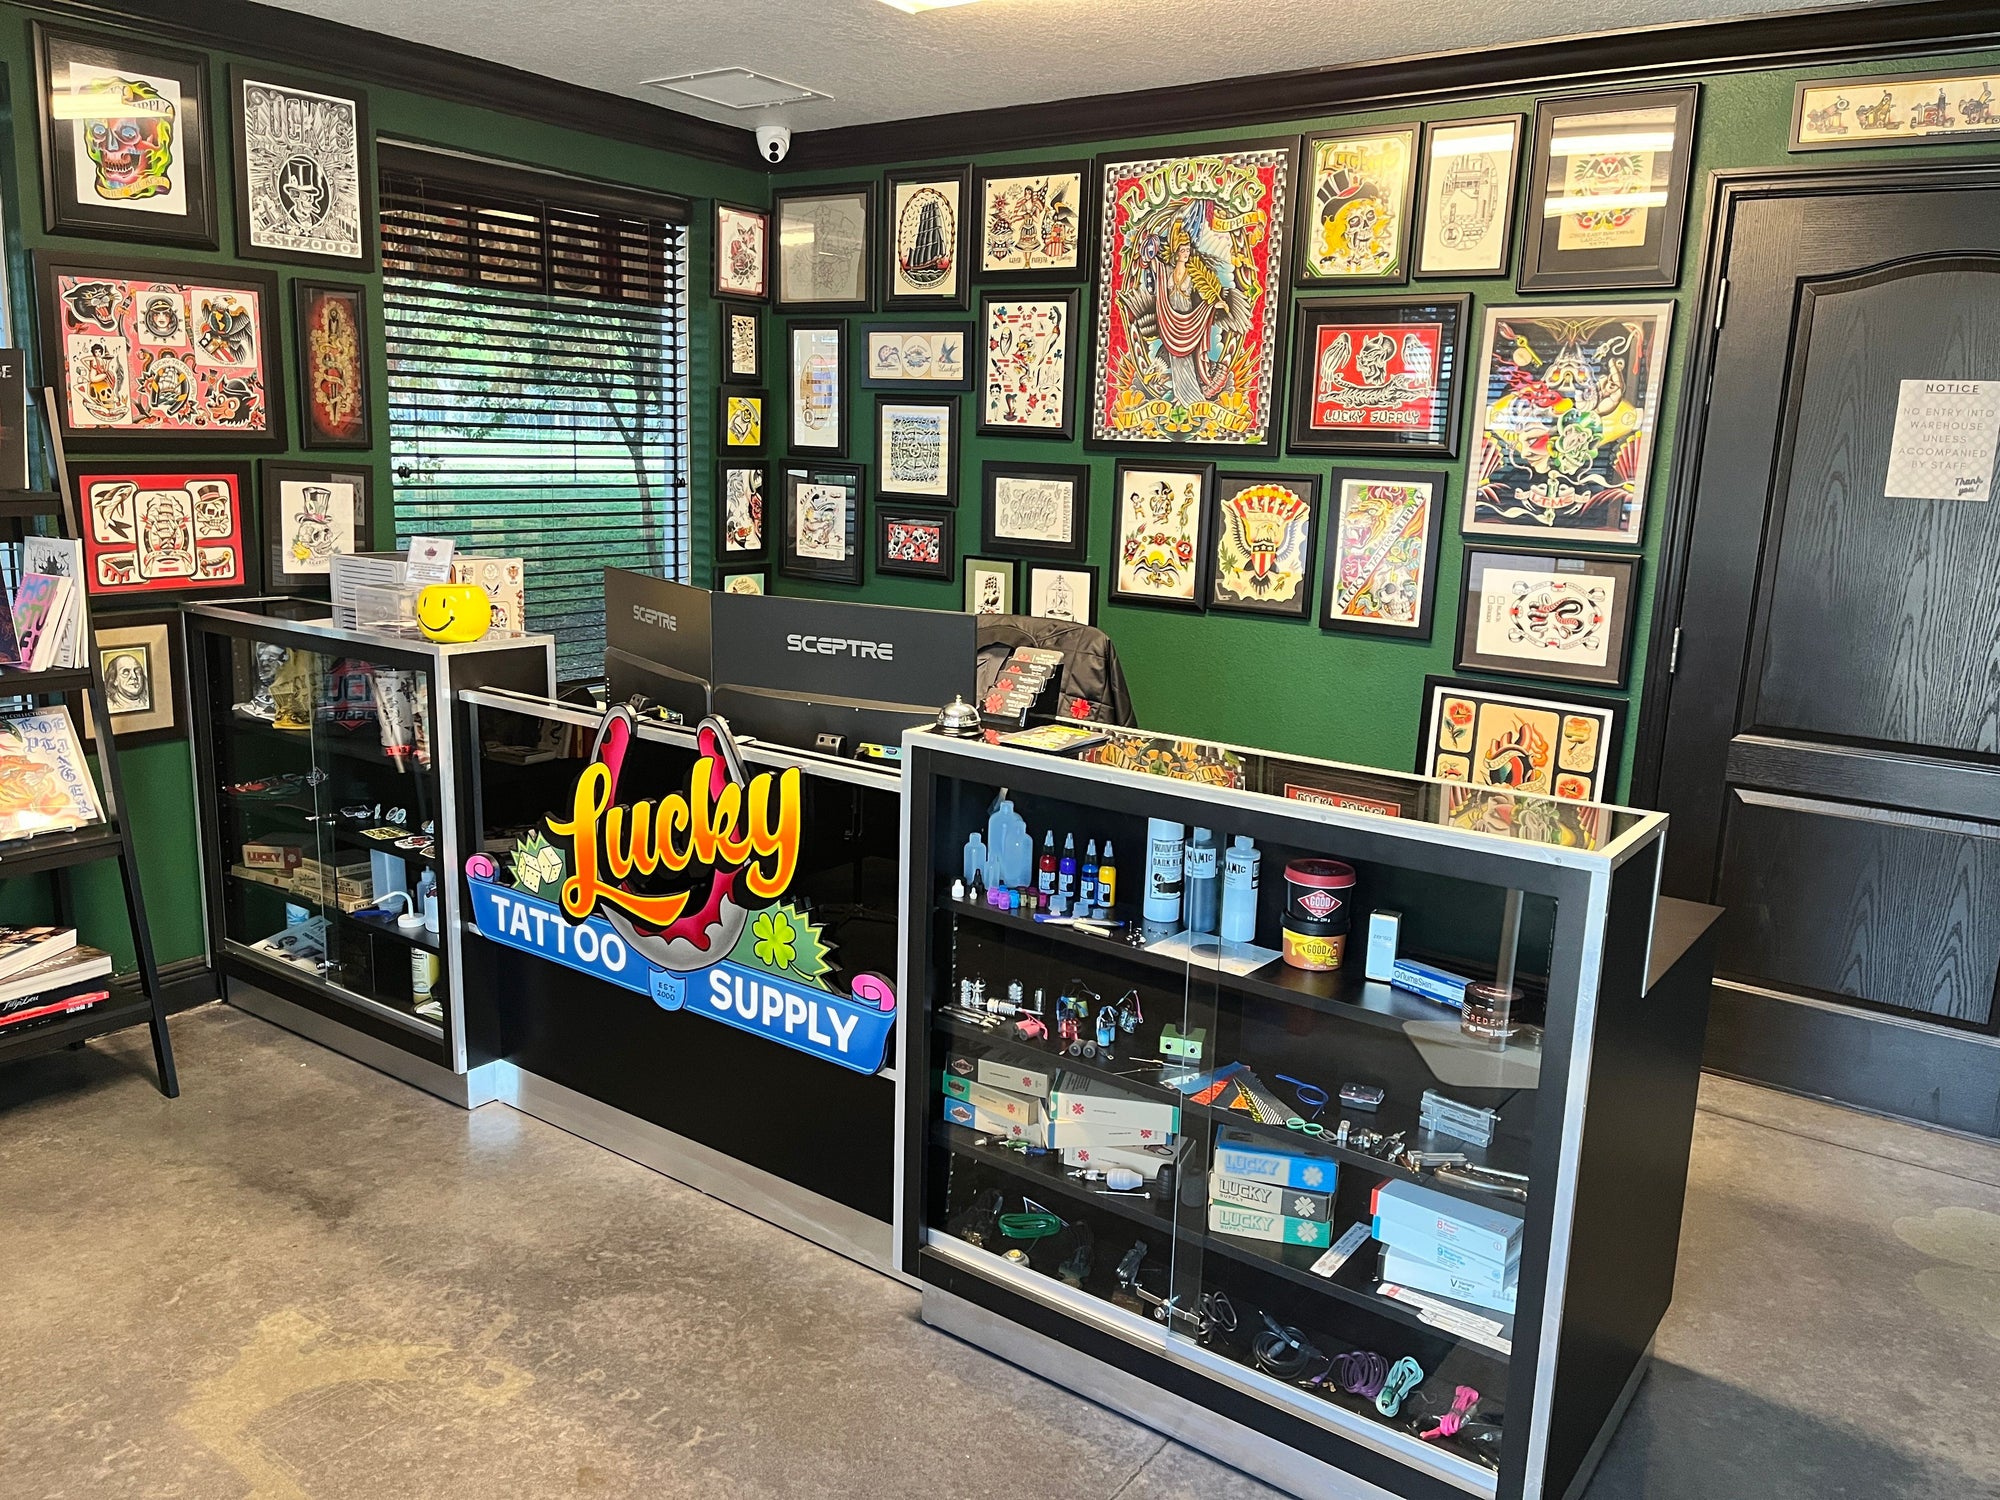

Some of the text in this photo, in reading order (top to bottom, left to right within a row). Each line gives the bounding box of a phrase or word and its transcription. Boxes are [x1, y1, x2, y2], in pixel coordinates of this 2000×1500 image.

[130, 100, 171, 114] UPPLY
[1214, 212, 1255, 232] SUPPLY
[152, 359, 170, 371] LUCKY
[171, 359, 191, 378] TATTOO
[1926, 384, 1980, 393] NOTICE
[1121, 403, 1244, 428] TATTOO MUSEUM
[1323, 409, 1421, 425] LUCKY SUPPLY
[1903, 407, 1995, 418] NO ENTRY INTO
[1910, 421, 1984, 431] WAREHOUSE
[1923, 435, 1967, 444] UNLESS
[1899, 447, 1988, 458] ACCOMPANIED
[1911, 460, 1967, 470] BY STAFF
[1954, 476, 1983, 487] Thank
[1958, 485, 1980, 497] you!
[1368, 534, 1396, 569] TATTOO
[1391, 491, 1424, 535] SUPPLY
[633, 604, 677, 632] SCEPTRE
[787, 633, 893, 661] SCEPTRE
[545, 757, 801, 926] Lucky
[1309, 896, 1331, 909] GOOD
[491, 894, 627, 973] TATTOO
[1306, 944, 1327, 955] GOOD
[658, 981, 676, 993] EST.
[656, 989, 676, 1001] 2000
[709, 969, 858, 1053] SUPPLY
[1225, 1154, 1280, 1176] LUCKY
[1219, 1178, 1273, 1203] LUCKY
[1219, 1193, 1244, 1203] SUPPLY
[1219, 1210, 1274, 1232] LUCKY
[1436, 1220, 1443, 1229] 8
